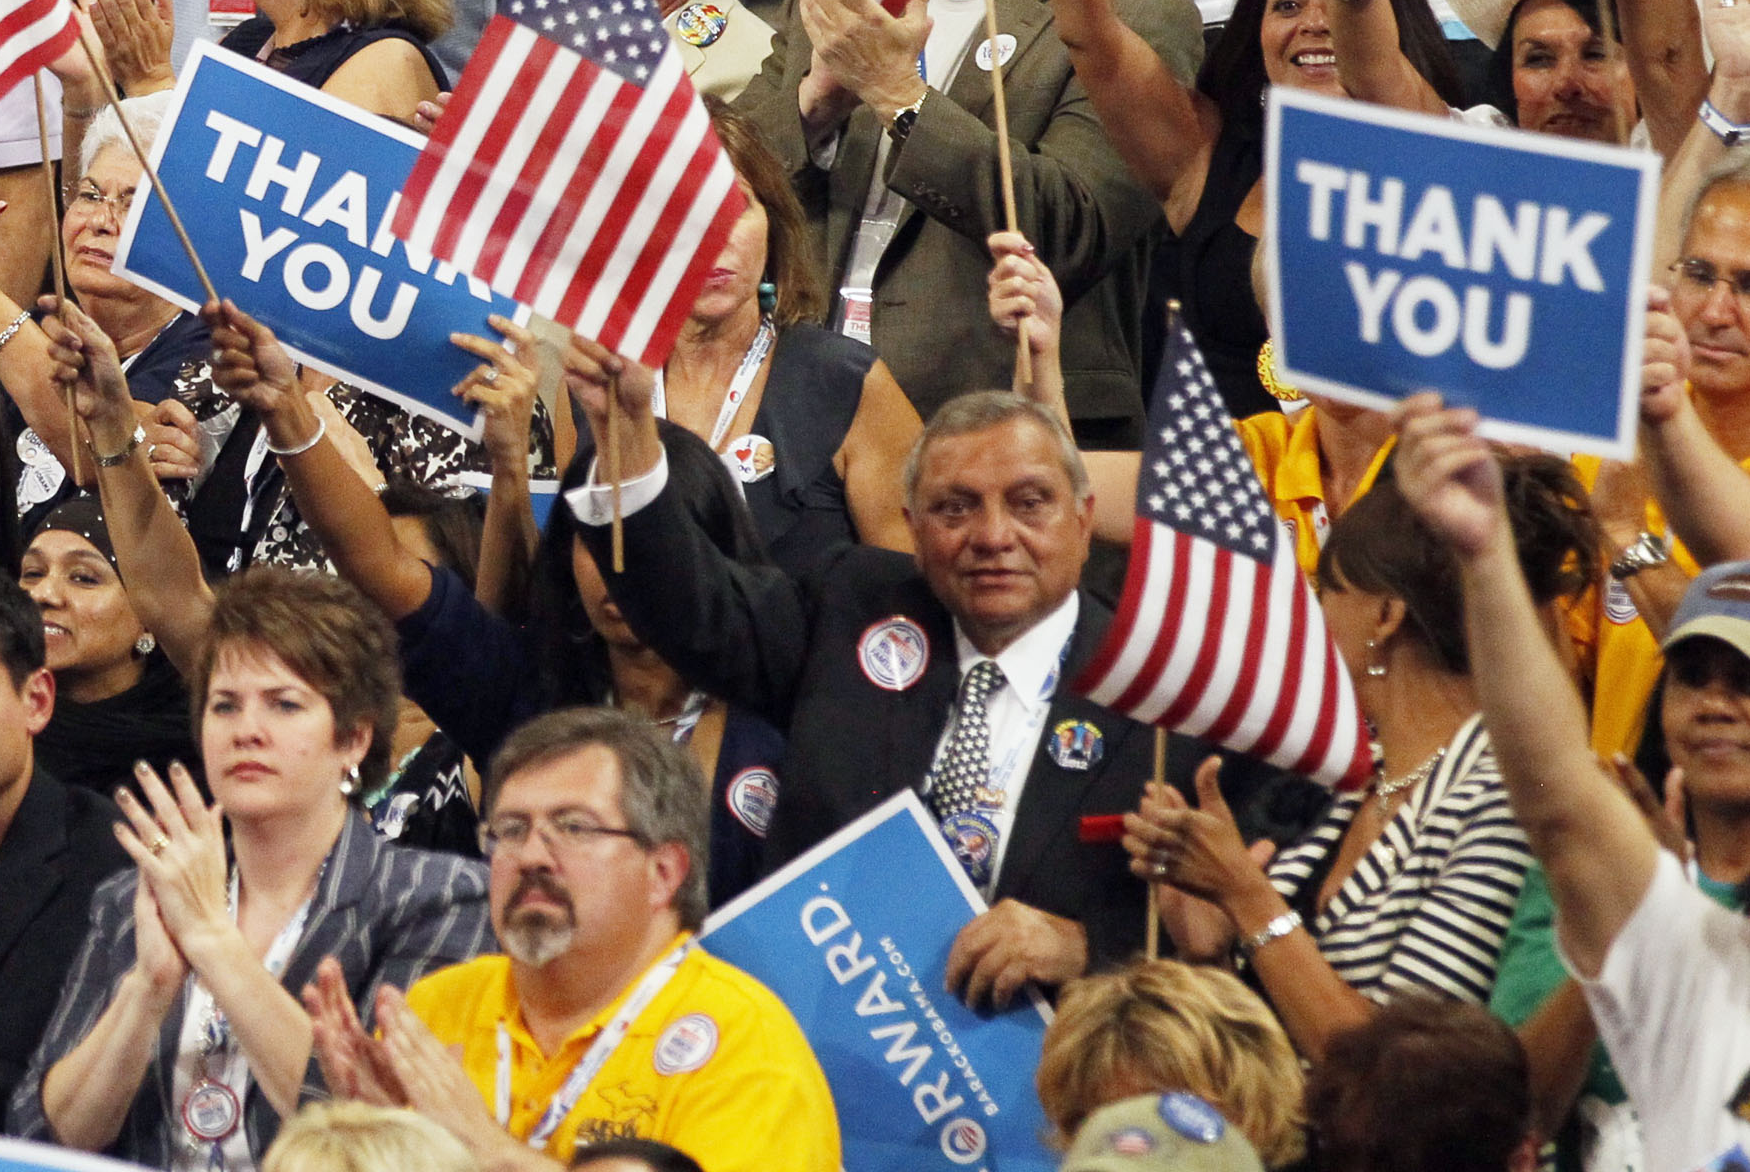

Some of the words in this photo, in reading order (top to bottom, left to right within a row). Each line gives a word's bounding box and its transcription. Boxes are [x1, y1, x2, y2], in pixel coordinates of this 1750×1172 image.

[239, 207, 421, 340] YOU
[1297, 160, 1611, 293] THANK
[1344, 262, 1532, 369] YOU
[799, 882, 991, 1172] ORWARD.
[878, 935, 1000, 1118] BARACKOBAMA.COM
